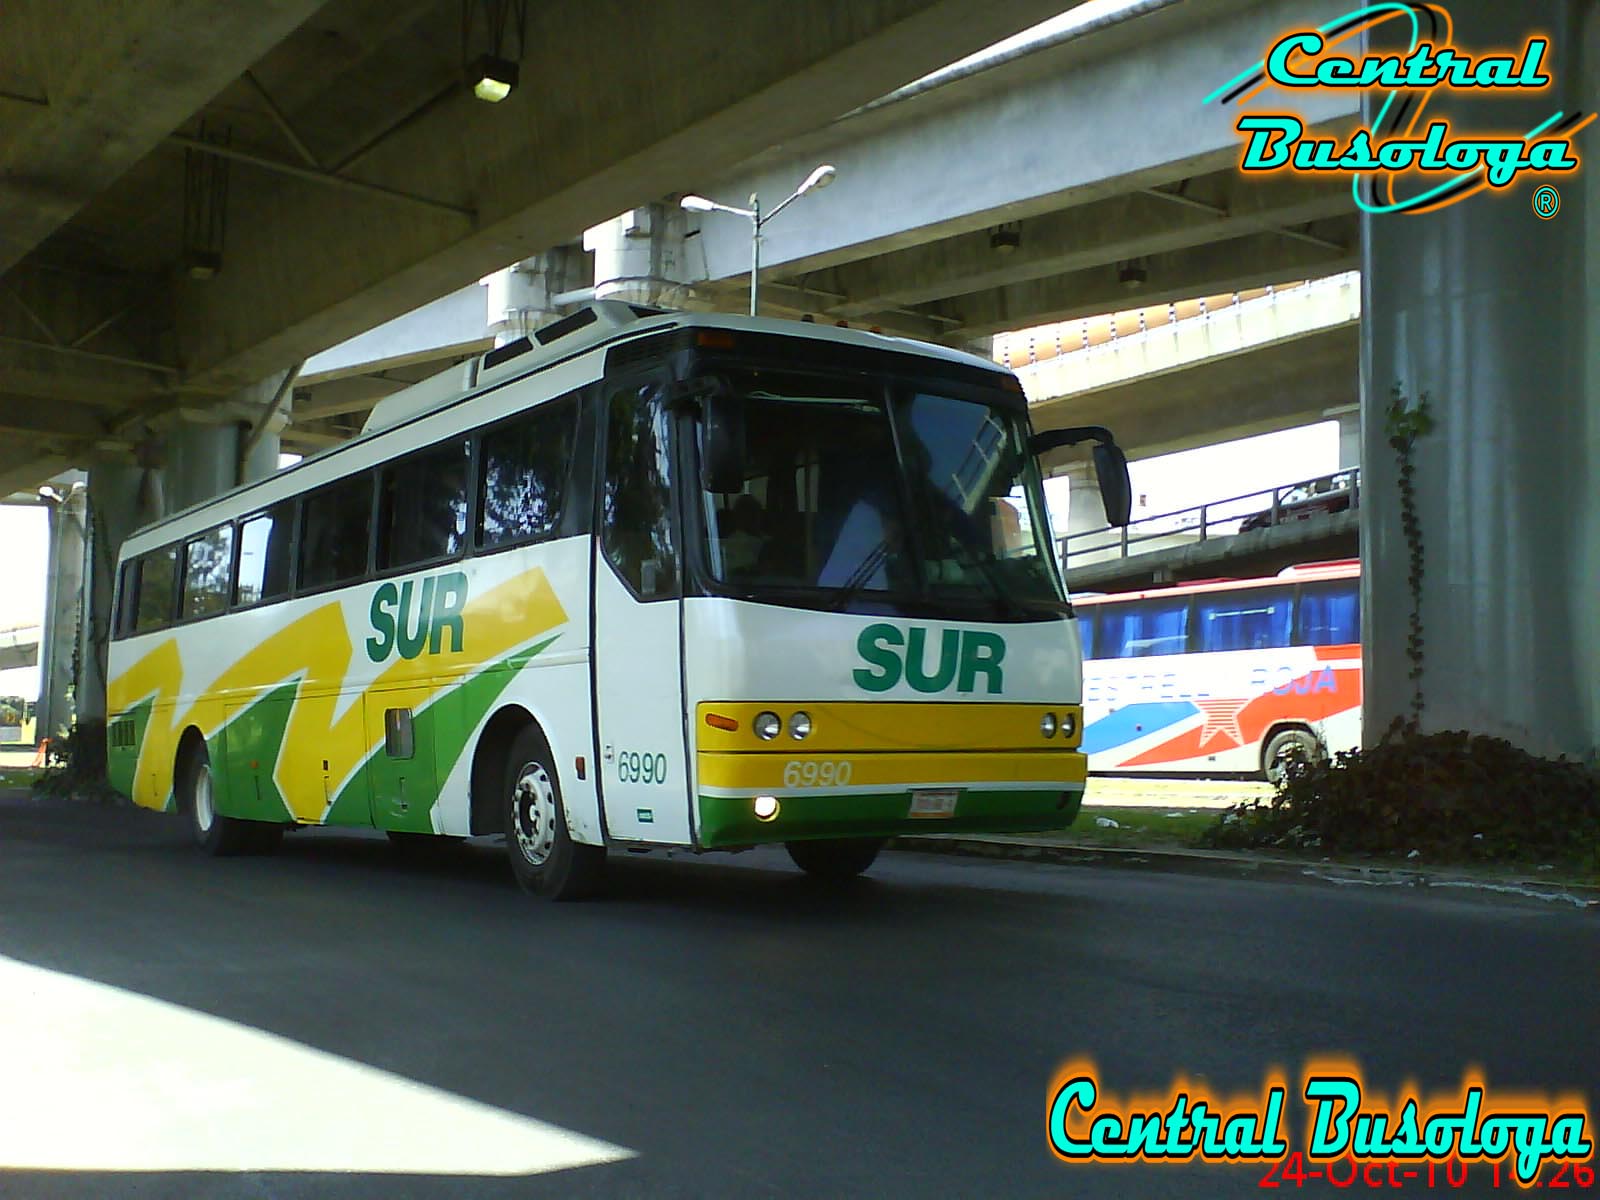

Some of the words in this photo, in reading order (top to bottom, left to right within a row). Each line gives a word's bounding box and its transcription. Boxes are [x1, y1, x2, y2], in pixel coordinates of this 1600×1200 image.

[366, 571, 469, 663] SUR
[852, 622, 1007, 694] SUR
[618, 751, 667, 784] 6990
[783, 761, 853, 788] 6990
